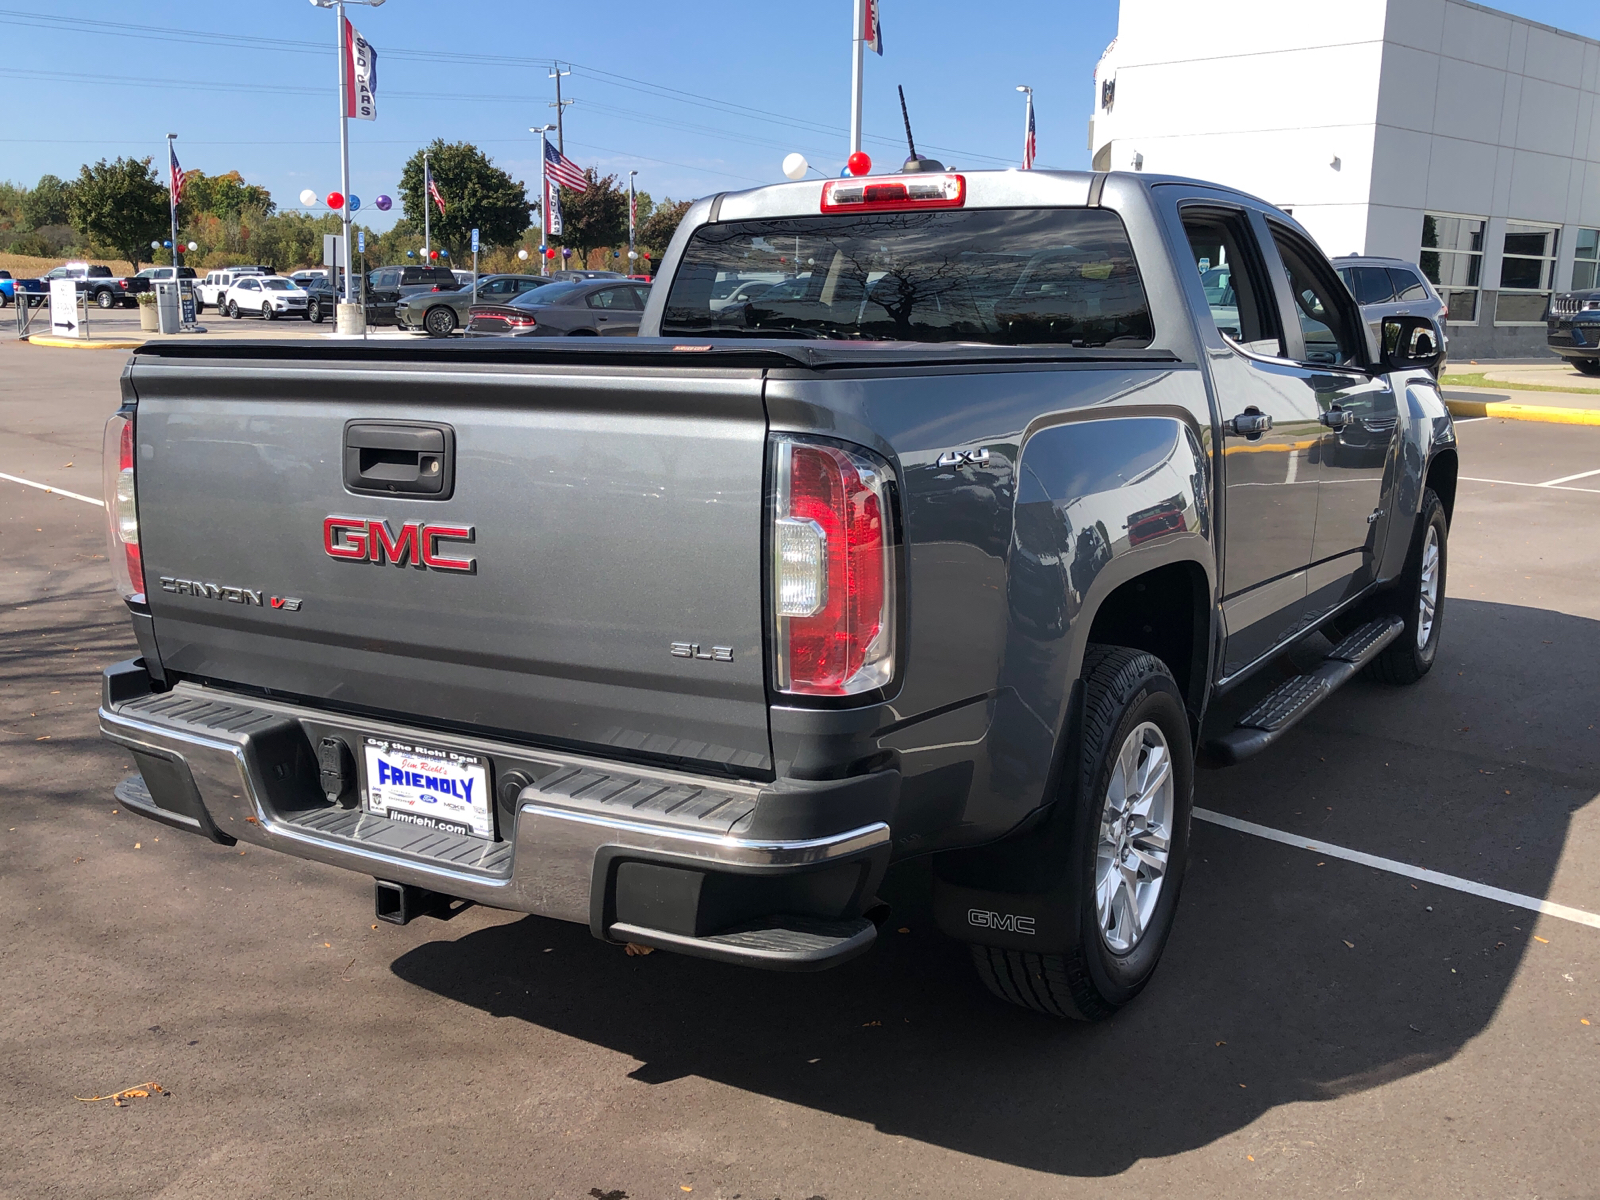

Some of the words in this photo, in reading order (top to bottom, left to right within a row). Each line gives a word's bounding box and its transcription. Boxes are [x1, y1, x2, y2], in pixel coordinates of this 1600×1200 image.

[356, 74, 371, 116] CARS
[323, 514, 477, 575] GMC
[159, 576, 264, 607] CANYON
[270, 595, 303, 612] V6
[670, 642, 734, 663] SLE
[367, 738, 389, 747] Get
[391, 743, 412, 752] the
[415, 747, 446, 758] Riehl
[449, 752, 478, 764] Deal
[377, 758, 475, 805] FRIENDLY
[401, 758, 418, 769] Jim
[420, 762, 448, 776] Riehl's
[967, 908, 1036, 935] GMC
